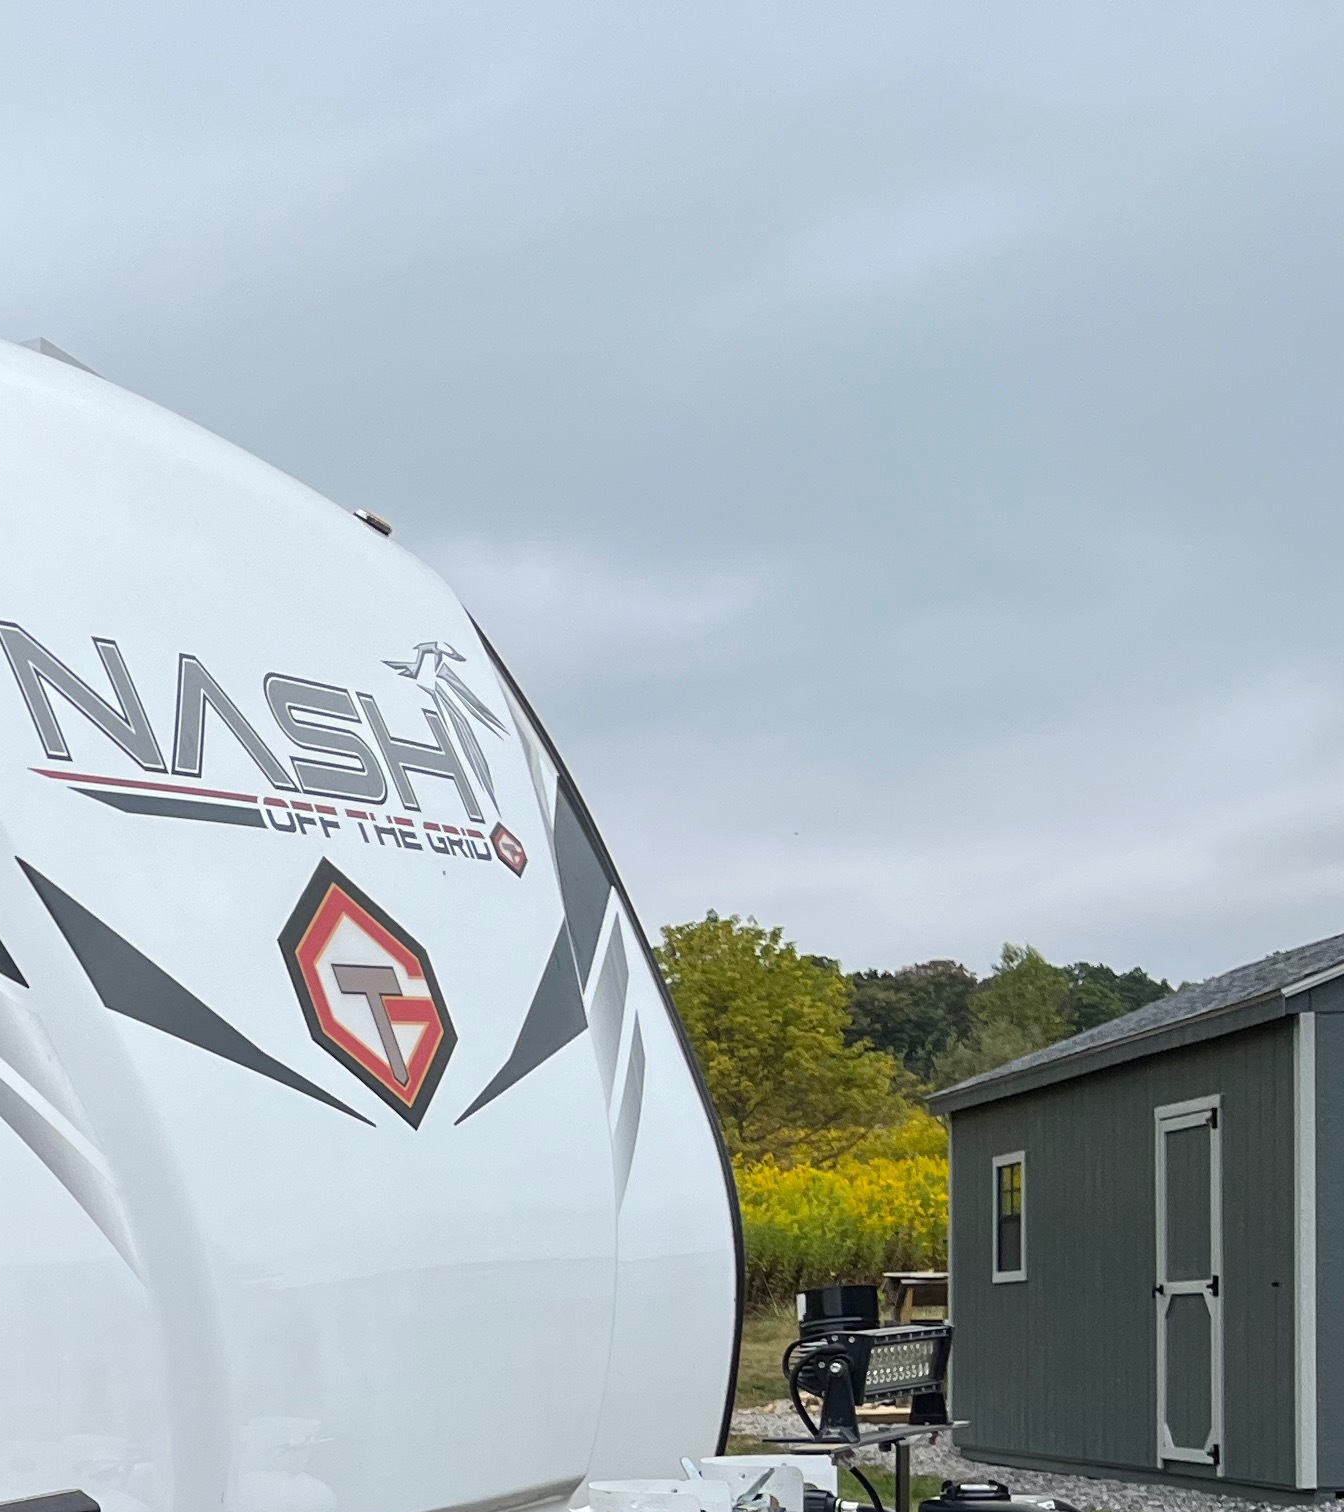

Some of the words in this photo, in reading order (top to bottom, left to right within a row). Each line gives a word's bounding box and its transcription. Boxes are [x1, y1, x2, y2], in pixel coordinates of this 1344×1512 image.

[263, 796, 340, 838] OFF
[345, 808, 424, 852] THE
[423, 821, 492, 861] GRID
